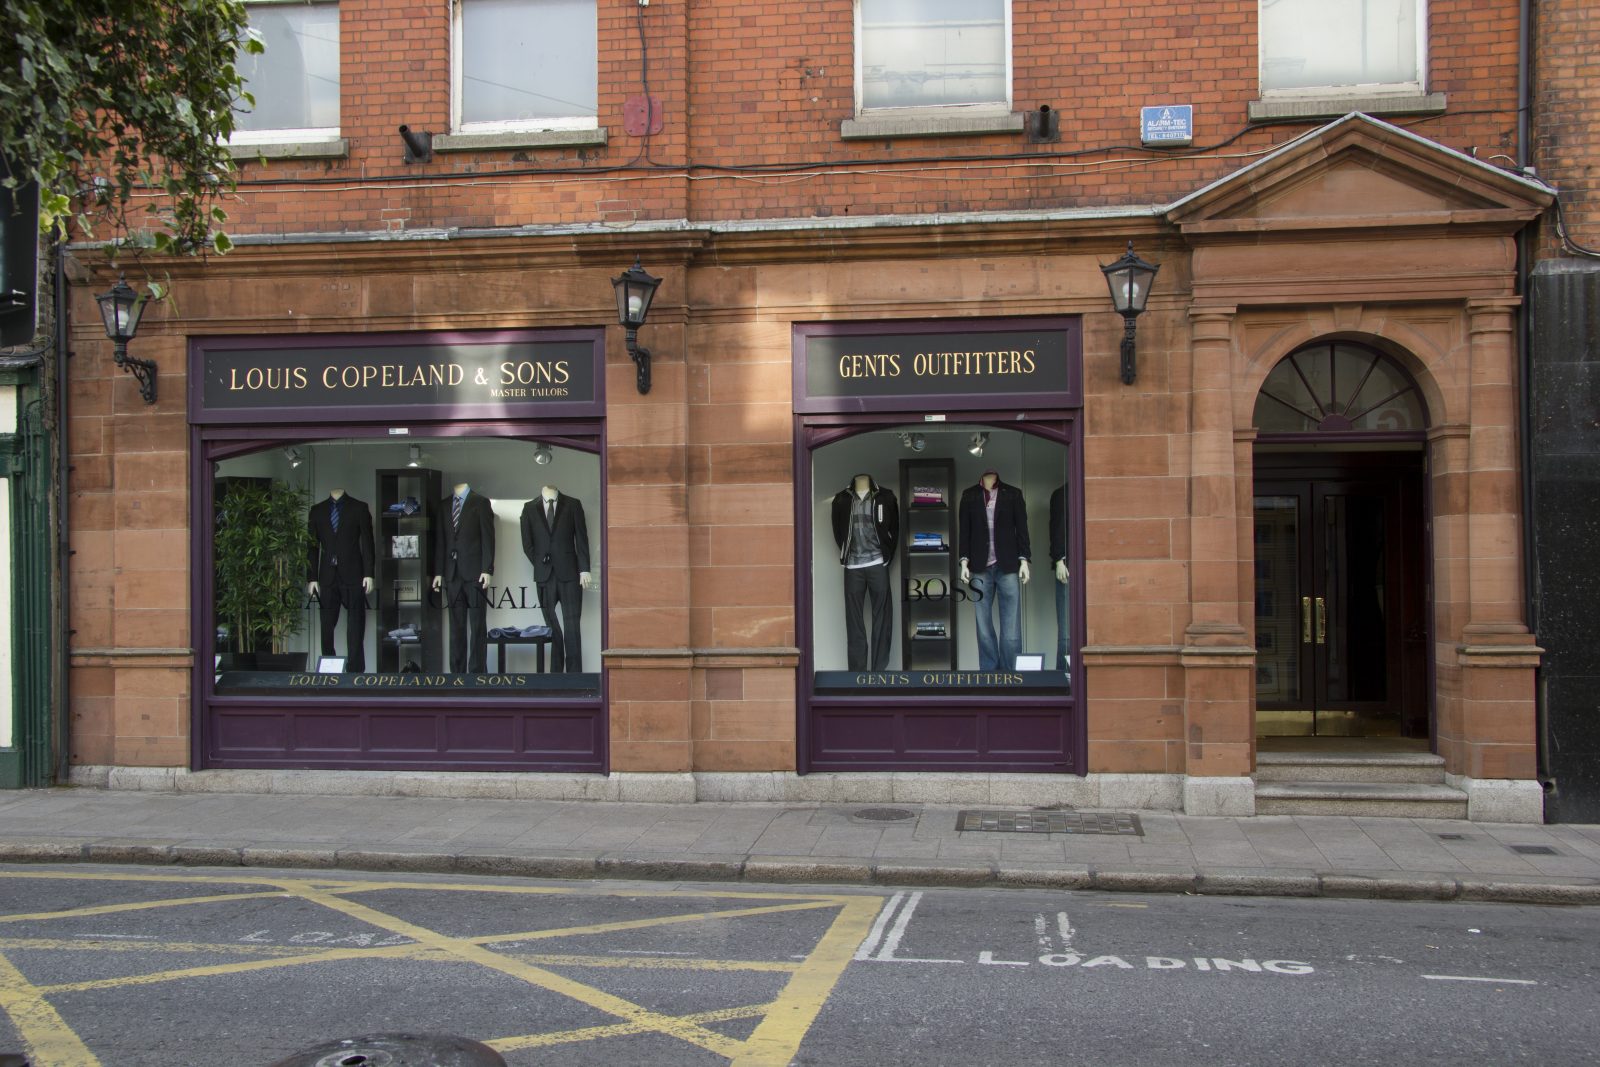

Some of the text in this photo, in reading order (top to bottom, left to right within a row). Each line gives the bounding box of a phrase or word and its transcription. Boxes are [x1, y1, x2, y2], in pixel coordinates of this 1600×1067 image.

[229, 360, 570, 391] LOUIS COPELAND & SONS
[839, 350, 1036, 378] GENTS OUTFITTERS
[490, 386, 569, 398] MASTER TAILORS
[427, 585, 548, 610] CANALI
[903, 577, 985, 603] BOSS
[288, 674, 527, 686] LOUIS COPELAND & SONS
[855, 673, 1024, 685] GENTS OUTFITTERS
[977, 951, 1315, 975] LOADING
